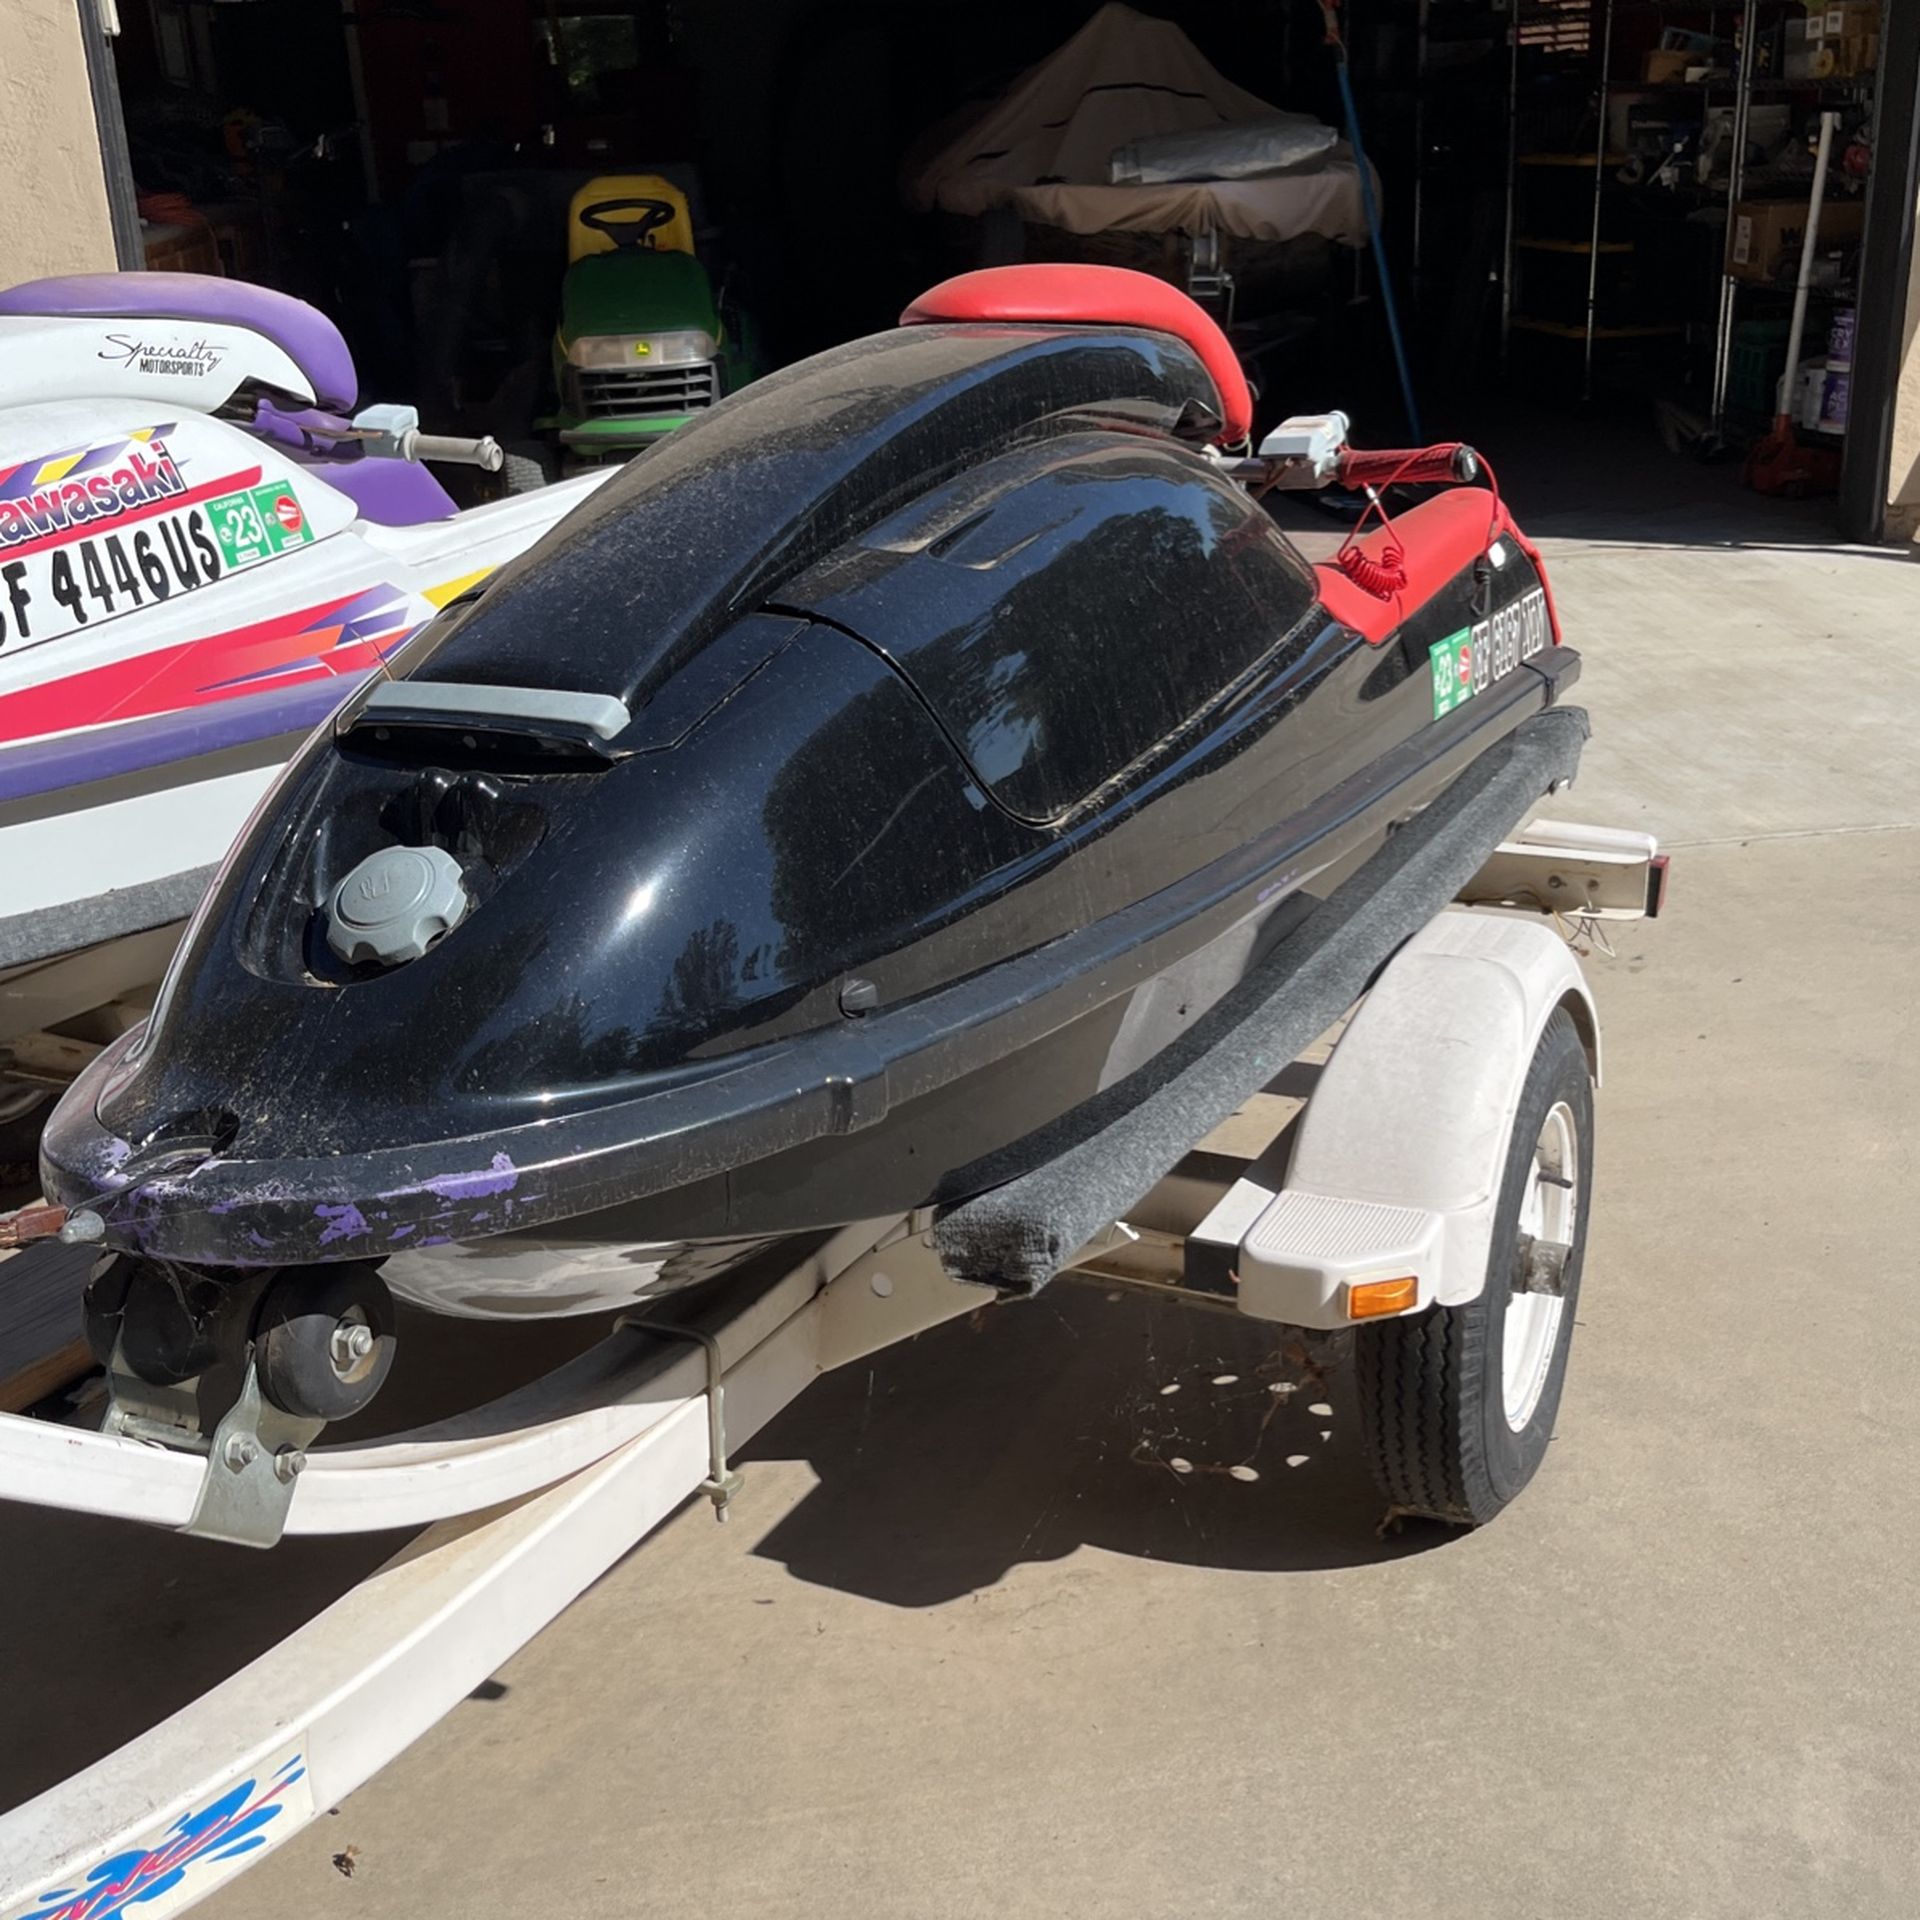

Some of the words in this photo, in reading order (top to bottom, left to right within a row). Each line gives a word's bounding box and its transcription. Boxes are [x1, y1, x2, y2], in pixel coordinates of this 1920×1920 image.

[97, 333, 229, 373] Specialty
[139, 357, 206, 376] MOTORSPORTS
[0, 441, 188, 548] awasaki
[226, 505, 263, 548] 23
